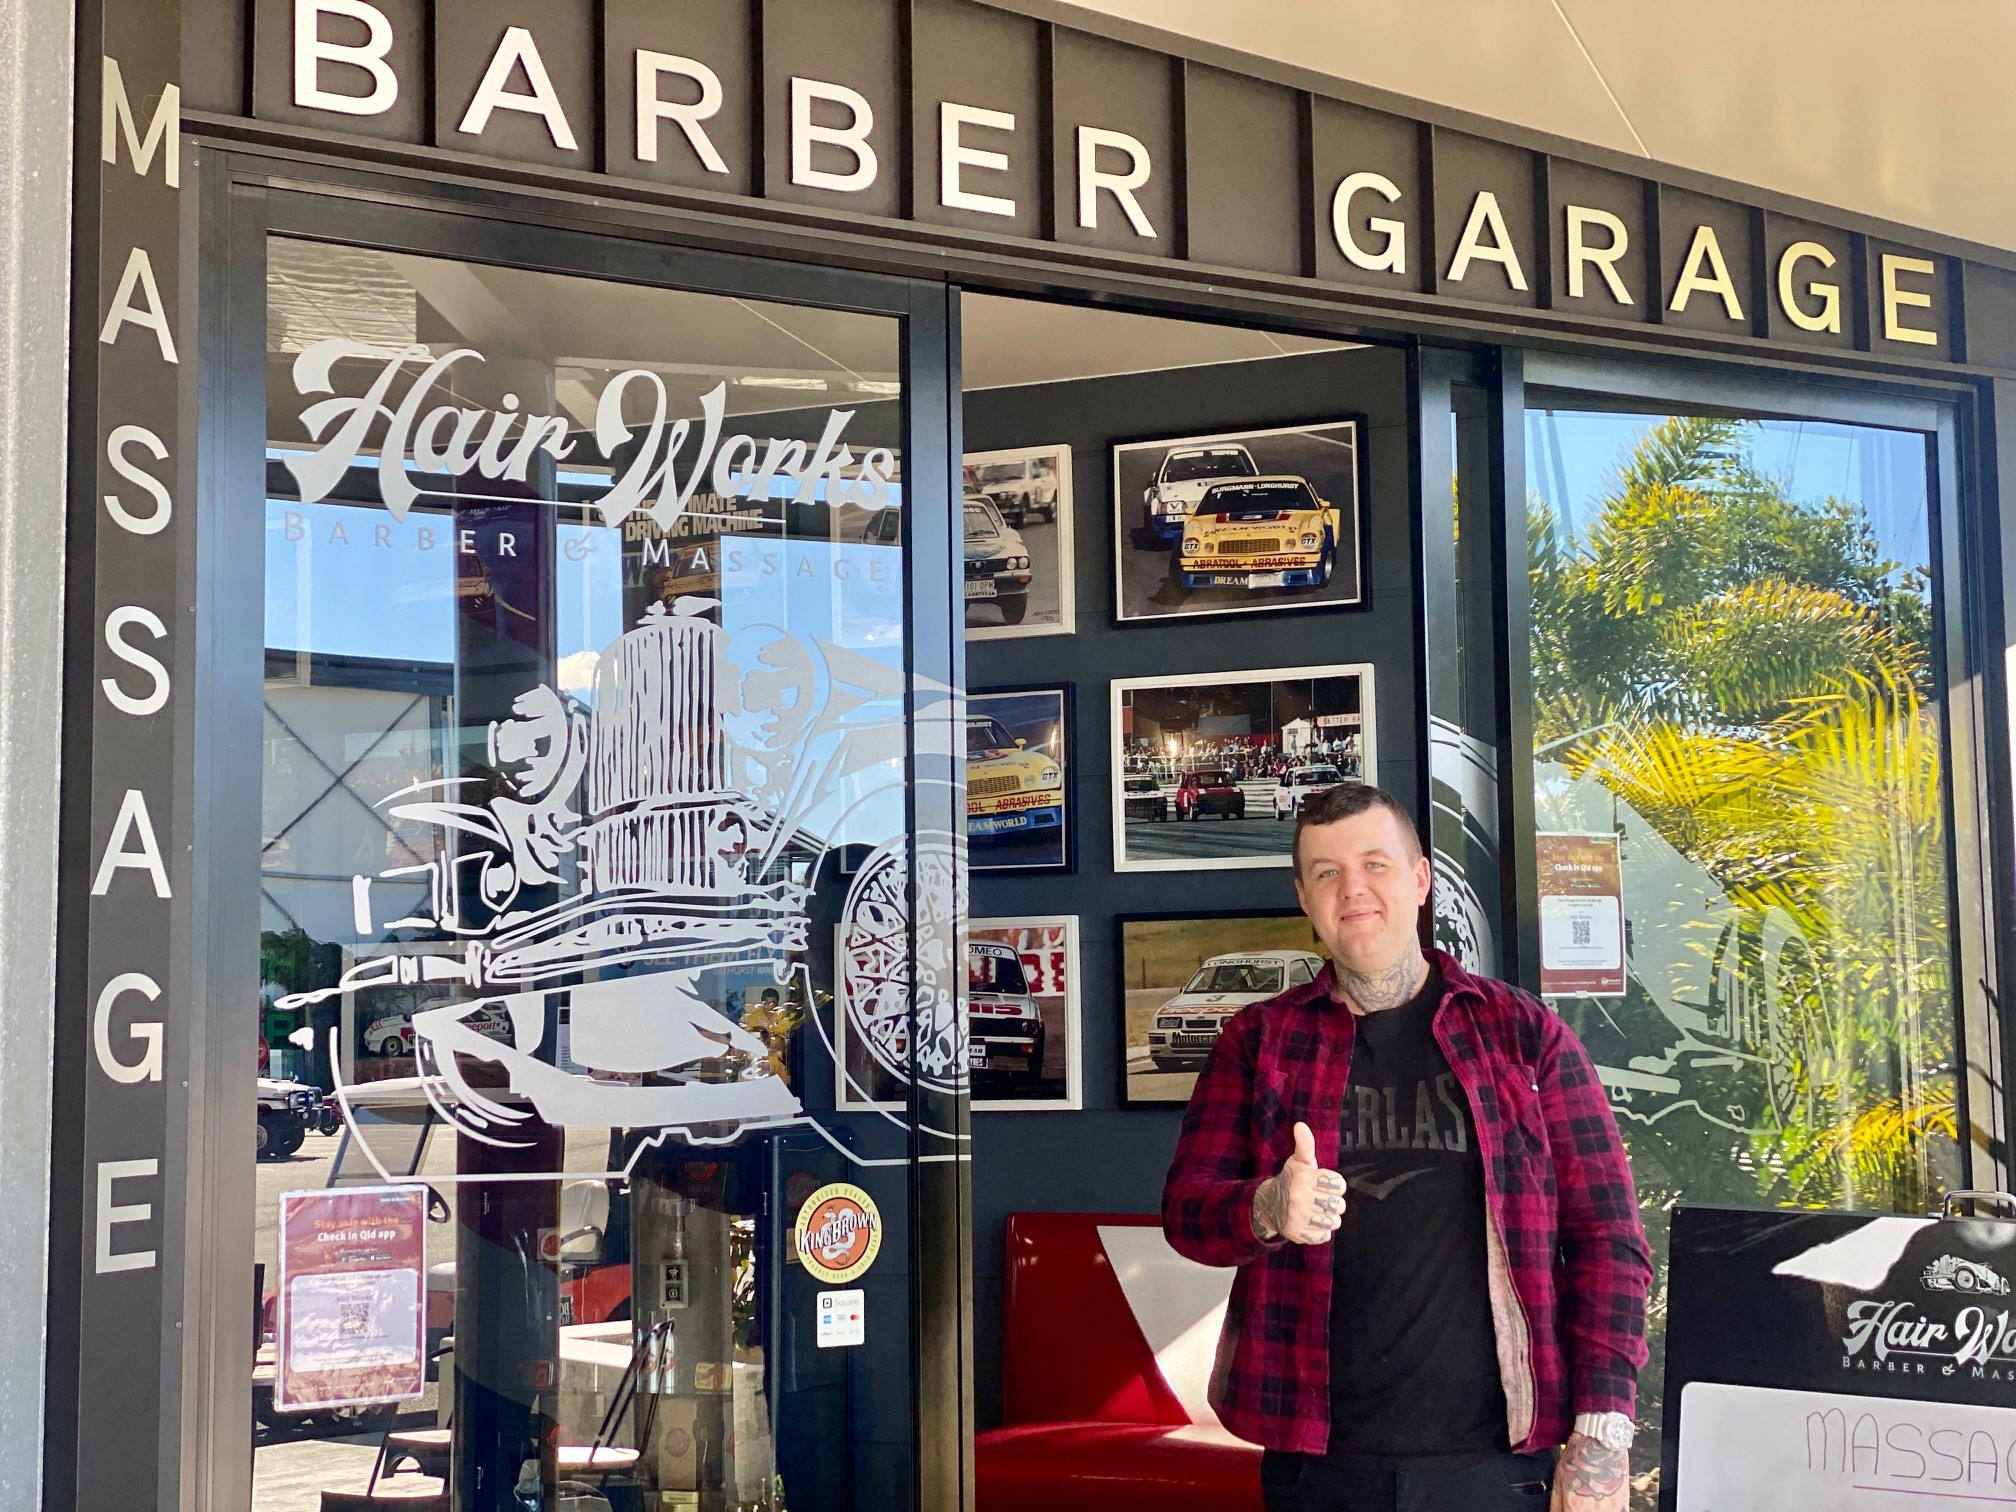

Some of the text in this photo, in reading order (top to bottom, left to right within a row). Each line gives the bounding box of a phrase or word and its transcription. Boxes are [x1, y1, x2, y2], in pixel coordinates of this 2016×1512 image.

[292, 0, 1938, 346] BARBER GARAGE
[282, 338, 895, 533] Hair Works
[692, 508, 763, 536] MACHINE
[285, 511, 517, 557] BARBER
[642, 538, 886, 583] MASSAGE
[1184, 543, 1199, 551] GTX
[1301, 538, 1316, 546] GTX
[91, 54, 180, 1274] MASSAGE
[1323, 717, 1349, 725] BETTER
[995, 793, 1052, 811] ABRASIVES
[1554, 864, 1573, 872] Check
[314, 1220, 336, 1231] Stay
[317, 1231, 346, 1242] Check
[359, 1229, 376, 1240] Qld
[378, 1230, 396, 1241] app
[834, 1299, 860, 1307] Square
[1842, 1300, 1948, 1361] Hair
[1842, 1356, 1925, 1374] BARBER
